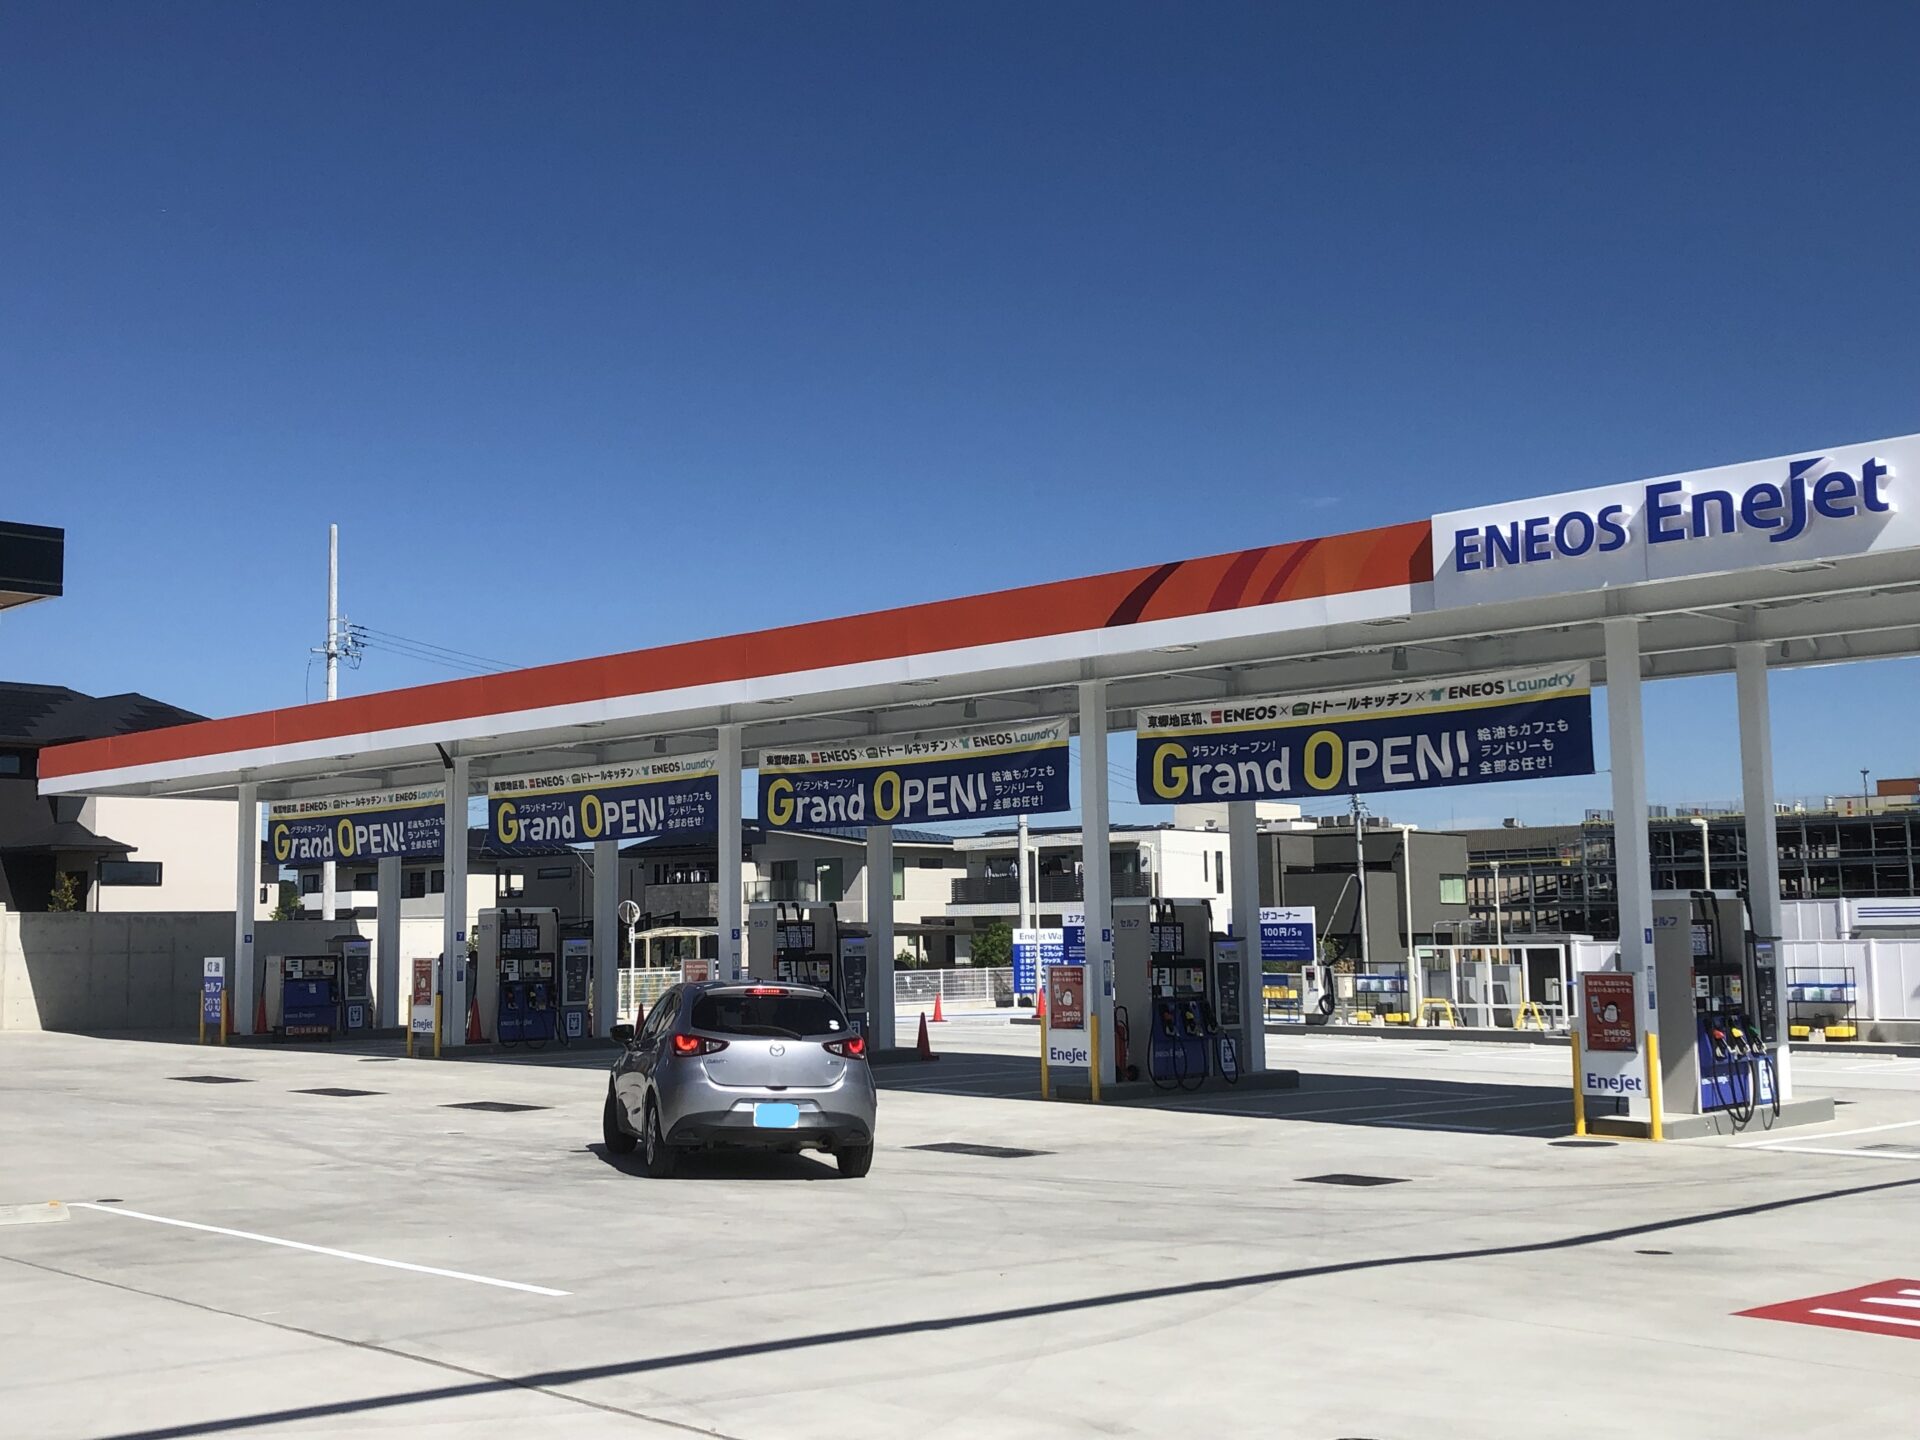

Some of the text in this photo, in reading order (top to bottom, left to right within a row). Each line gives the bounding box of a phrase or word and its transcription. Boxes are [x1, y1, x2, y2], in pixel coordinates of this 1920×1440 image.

[1455, 457, 1890, 572] ENEOS Enejet
[1223, 705, 1277, 722] ENEOS
[1311, 692, 1412, 714] ドトールキッチン
[1448, 680, 1505, 699] ENEOS
[1508, 673, 1575, 692] Laundry
[1477, 718, 1569, 741] 給油もカフェも
[820, 748, 857, 763] ENEOS
[879, 740, 948, 757] ドトールキッチン
[973, 733, 1013, 747] ENEOS
[1014, 728, 1059, 743] Laundry
[1481, 738, 1554, 757] ランドリーも
[536, 775, 564, 788] ENEOS
[581, 768, 634, 783] ドトールキッチン
[651, 762, 680, 775] ENEOS
[681, 759, 715, 771] Laundry
[991, 765, 1055, 783] 給油もカフェも
[1153, 730, 1470, 799] Grand OPEN!
[1479, 755, 1553, 775] 全部お任せ!
[767, 771, 988, 826] Grand OPEN!
[994, 781, 1044, 796] ランドリーも
[498, 794, 664, 843] Grand OPEN!
[274, 818, 407, 861] Grand OPEN!
[1120, 919, 1139, 928] セルフ
[1020, 932, 1046, 941] Eneet
[205, 982, 222, 993] セルフ
[1050, 1047, 1087, 1064] Enejet
[1586, 1072, 1642, 1093] Enejet
